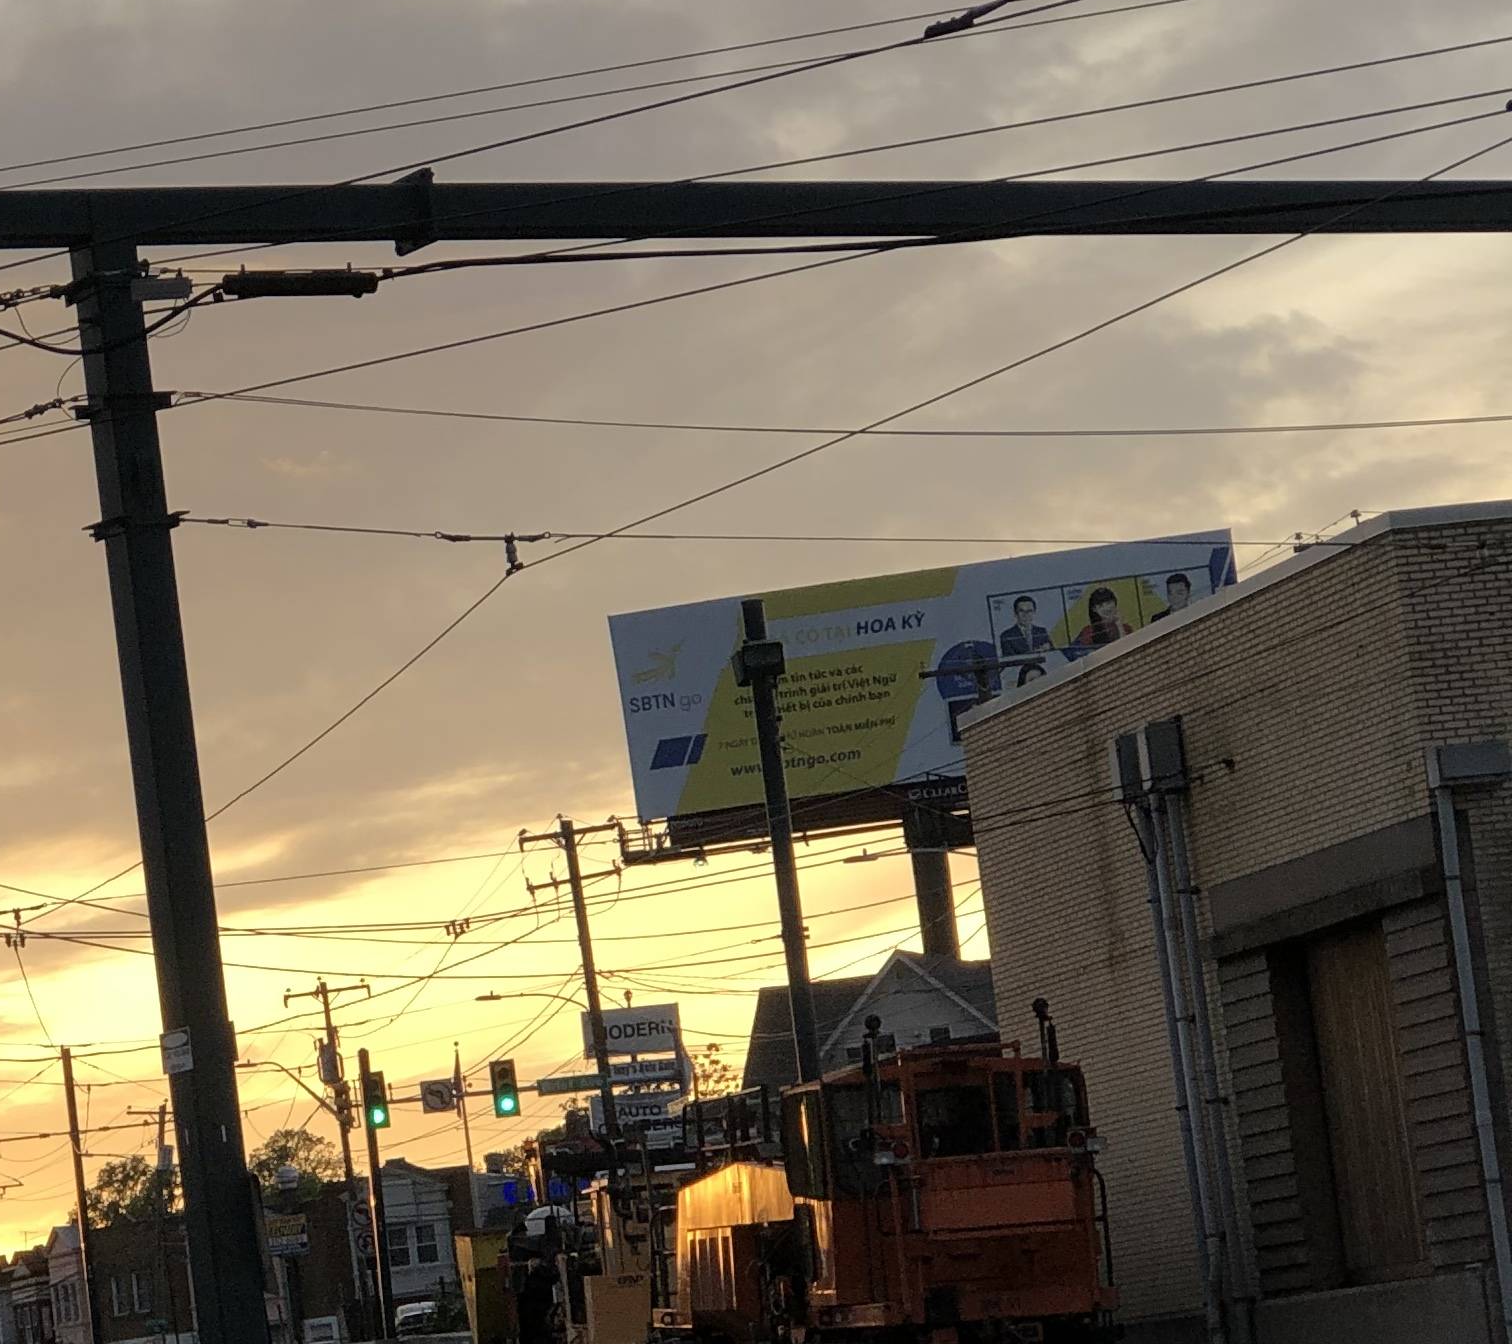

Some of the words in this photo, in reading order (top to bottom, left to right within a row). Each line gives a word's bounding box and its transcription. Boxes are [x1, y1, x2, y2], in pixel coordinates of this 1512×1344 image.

[856, 617, 896, 636] HOA
[901, 610, 926, 629] KỲ
[629, 692, 676, 713] SBTN
[679, 693, 702, 712] go
[604, 1019, 674, 1041] ODERN
[618, 1104, 662, 1119] AUTO
